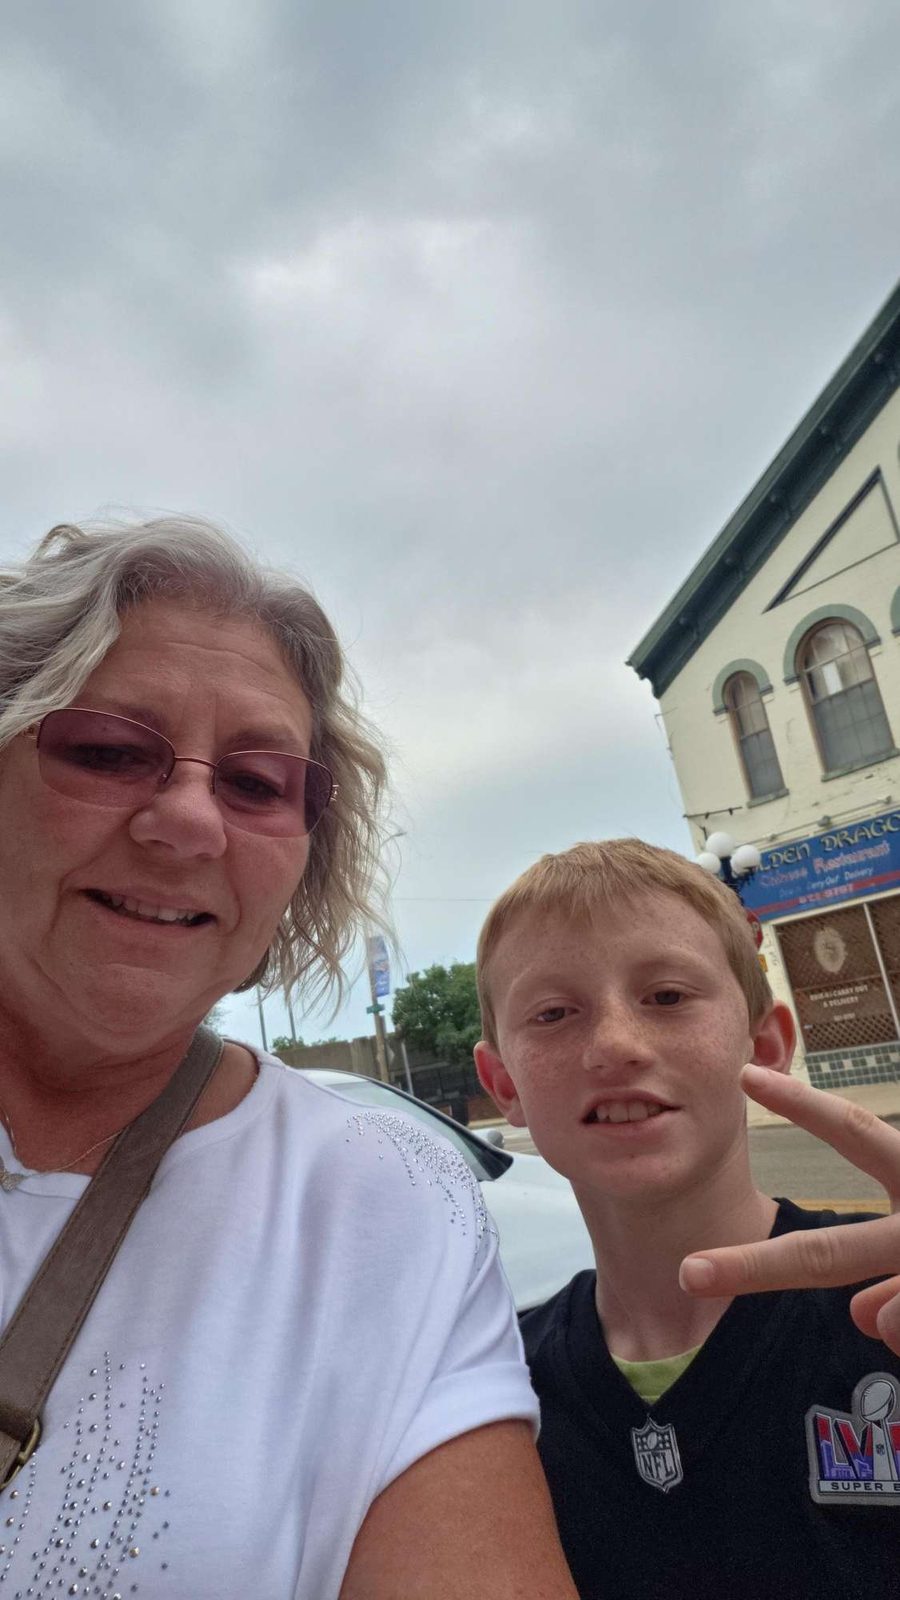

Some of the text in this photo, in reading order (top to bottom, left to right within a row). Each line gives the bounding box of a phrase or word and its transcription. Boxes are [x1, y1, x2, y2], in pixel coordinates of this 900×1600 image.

[758, 842, 811, 871] LDEN
[640, 1450, 676, 1480] NFL
[831, 1482, 884, 1491] SUPER
